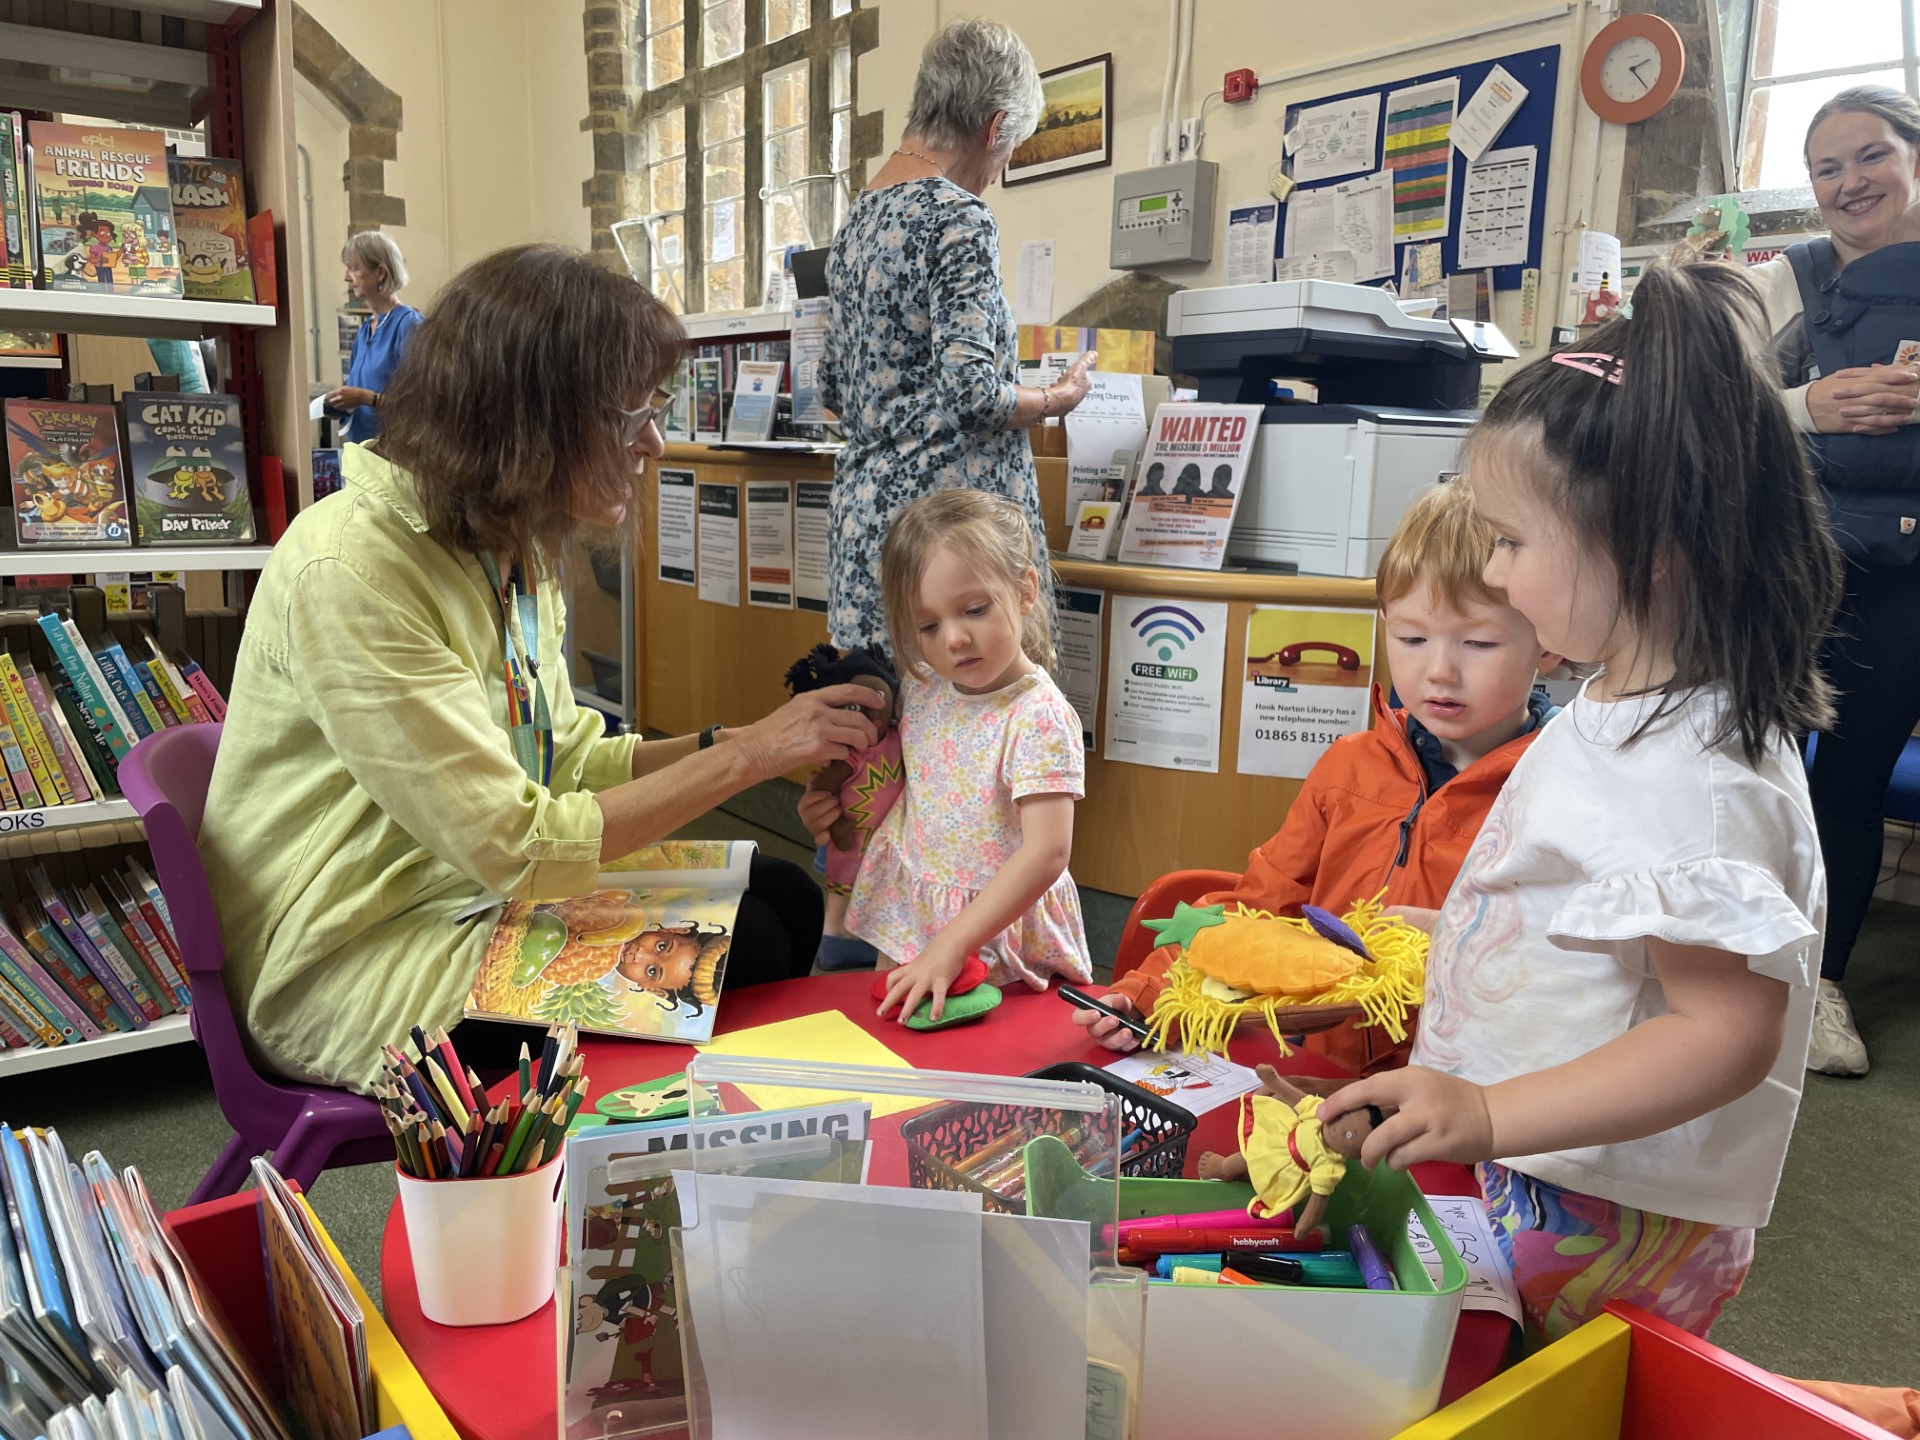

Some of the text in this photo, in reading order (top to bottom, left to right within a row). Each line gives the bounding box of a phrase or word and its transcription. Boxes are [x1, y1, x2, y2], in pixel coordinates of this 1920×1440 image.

[44, 146, 152, 164] ANIMAL RESCUE
[171, 184, 230, 208] LASH
[185, 218, 220, 232] HOLIDAY
[1105, 392, 1130, 402] Charges
[142, 404, 183, 424] CAT
[190, 426, 216, 436] CLUB
[1159, 416, 1248, 442] WANTED
[1155, 442, 1168, 452] THE
[1170, 442, 1202, 452] MISSING
[1209, 443, 1242, 453] MILLION
[1073, 466, 1099, 475] Printing
[162, 518, 189, 532] DAV
[50, 626, 96, 704] Lift the Flap Nature
[1135, 664, 1192, 680] FREE WiFi
[98, 656, 117, 680] Little
[112, 680, 129, 700] Owl's
[1256, 676, 1288, 686] Library
[76, 700, 97, 730] Sleepy
[1255, 703, 1276, 712] Hook
[1277, 704, 1305, 712] Norton
[1306, 706, 1334, 716] Library
[1277, 715, 1316, 726] telephone
[1255, 728, 1297, 742] 01865
[27, 747, 42, 770] cub
[1, 960, 16, 977] MEET
[1233, 1238, 1280, 1248] hobbycraft
